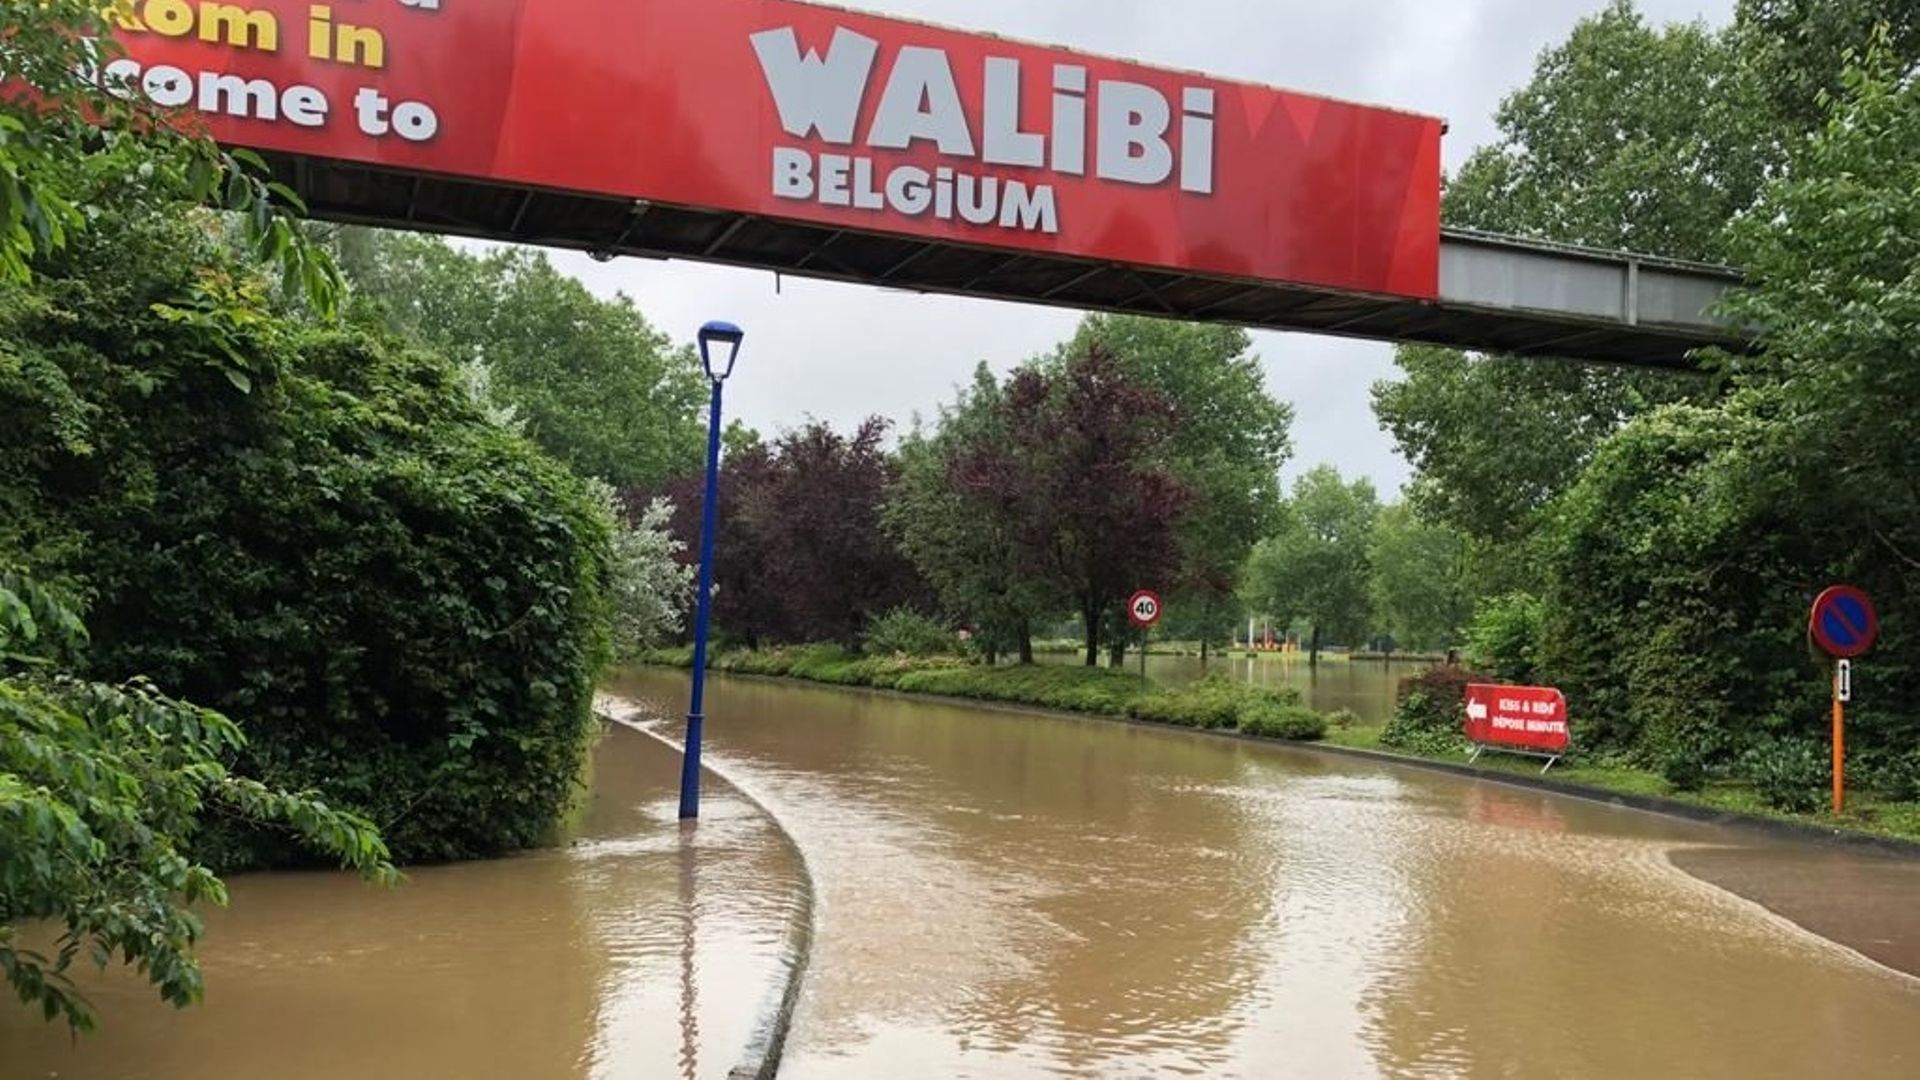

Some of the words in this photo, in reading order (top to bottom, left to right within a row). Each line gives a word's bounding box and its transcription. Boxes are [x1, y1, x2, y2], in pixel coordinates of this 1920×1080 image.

[309, 4, 384, 67] in
[354, 87, 437, 141] to
[1135, 601, 1155, 615] 40
[1499, 698, 1521, 712] KISS
